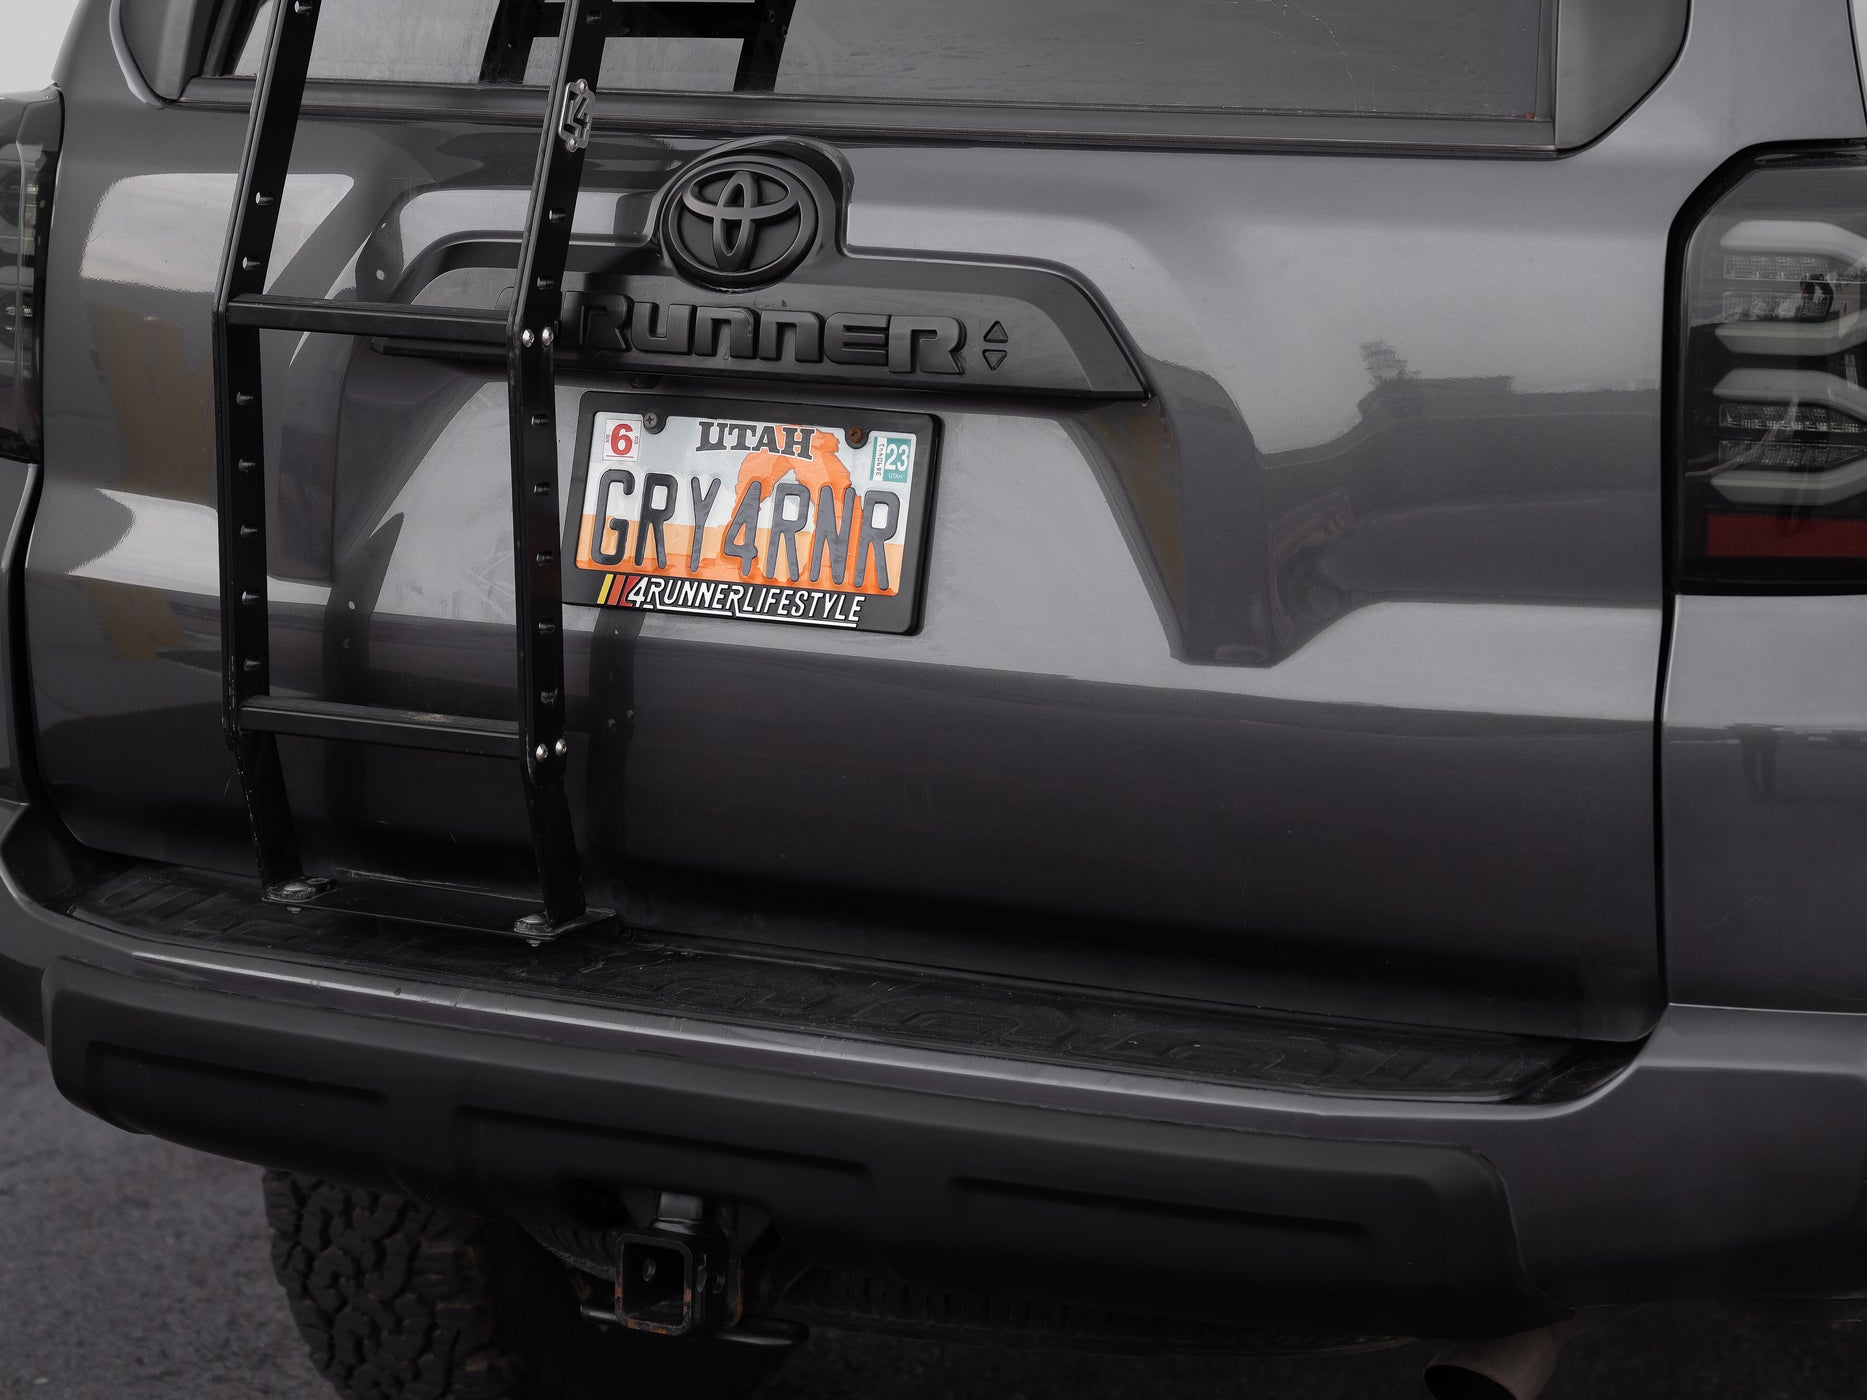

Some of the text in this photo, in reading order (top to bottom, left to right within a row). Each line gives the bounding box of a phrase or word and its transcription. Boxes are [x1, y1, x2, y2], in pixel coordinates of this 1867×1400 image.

[496, 286, 967, 376] RUNNER
[611, 423, 633, 455] 6
[695, 420, 816, 461] UTAH
[885, 444, 909, 471] 23
[591, 469, 901, 590] GRY4RNR
